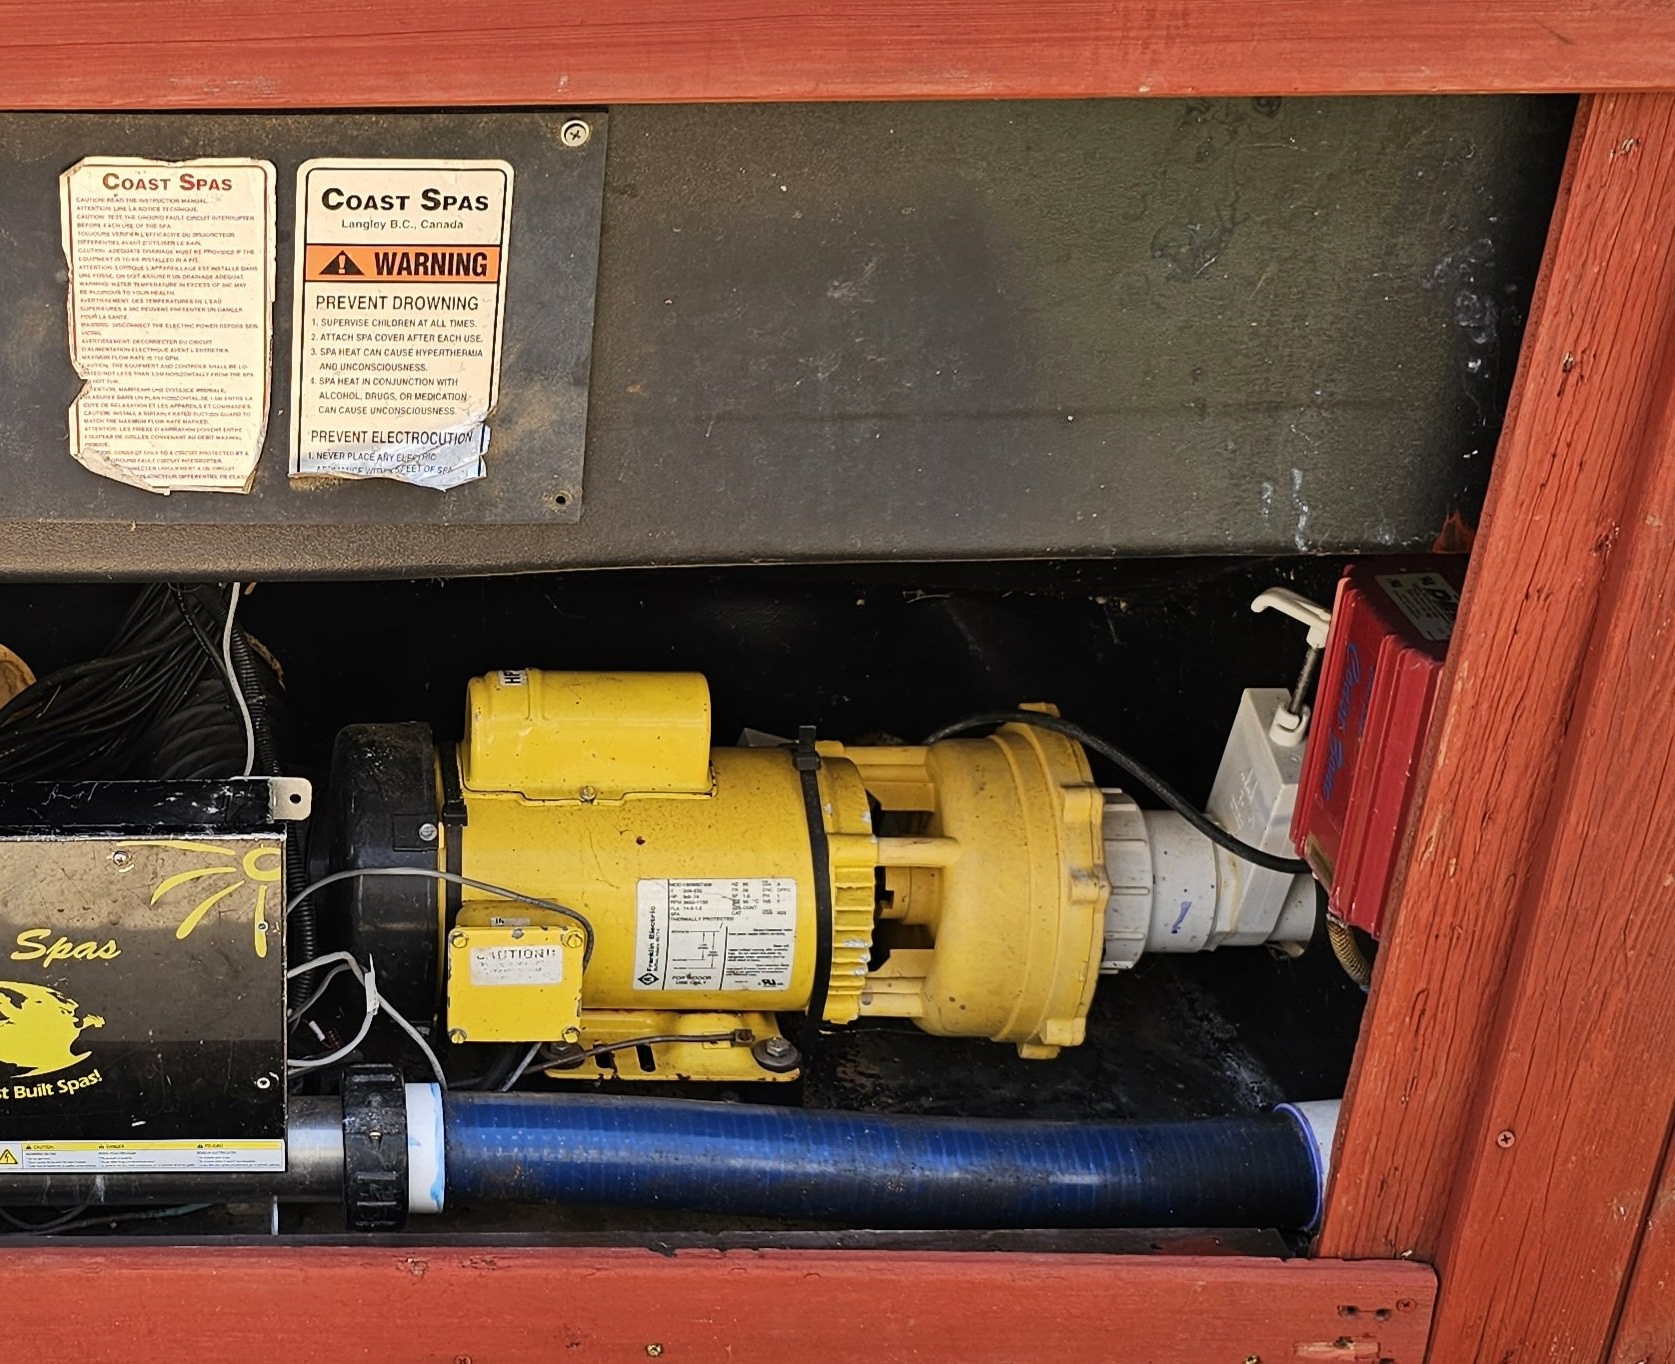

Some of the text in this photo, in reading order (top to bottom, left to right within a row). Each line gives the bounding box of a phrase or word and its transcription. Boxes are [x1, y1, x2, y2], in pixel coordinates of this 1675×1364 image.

[322, 188, 488, 211] COAST SPAS
[342, 220, 464, 230] Langley B.C., Canada
[375, 252, 487, 276] WARNING
[316, 295, 478, 311] PREVENT DROWNING
[321, 319, 369, 327] SUPERVISE
[372, 319, 415, 327] CHILDREN
[418, 319, 428, 327] AT
[431, 319, 447, 327] ALL
[450, 319, 477, 327] TIMES.
[407, 334, 434, 342] AFTER
[438, 334, 461, 342] EACH
[320, 348, 336, 356] SPA
[339, 348, 360, 356] HEAT
[364, 348, 381, 356] CAN
[384, 348, 413, 357] CAUSE
[416, 349, 483, 357] HYPERTHERMIA
[319, 363, 427, 371] AND UNCONSCIOUSNESS.
[373, 378, 434, 386] CONJUNCTION
[437, 378, 458, 386] WITH
[319, 392, 363, 401] ALCOHOL,
[365, 392, 397, 401] DRUGS,
[415, 393, 467, 401] MEDICATION
[319, 406, 456, 415] CAN CAUSE UNCONSCIOUSNESS.
[311, 430, 473, 445] PREVENT ELECTROCUTION
[317, 452, 344, 460] NEVER
[348, 453, 375, 461] PLACE
[377, 453, 393, 462] ANY
[424, 465, 436, 473] OF
[11, 928, 121, 968] Spas
[14, 1083, 53, 1099] Built
[58, 1069, 103, 1094] Spas!
